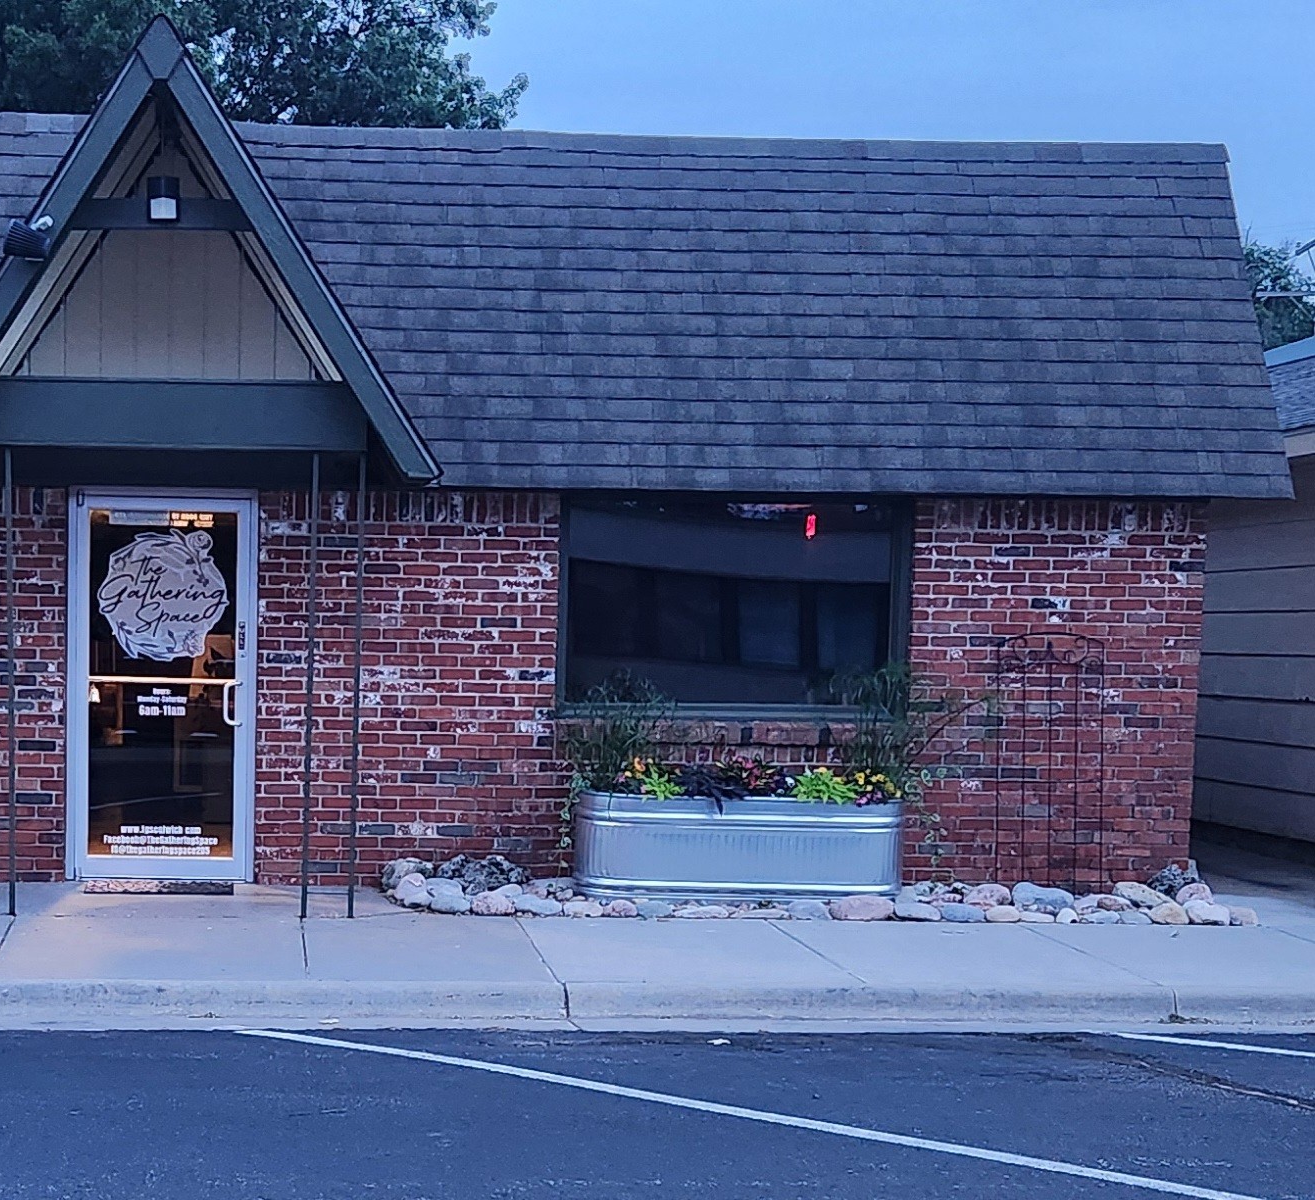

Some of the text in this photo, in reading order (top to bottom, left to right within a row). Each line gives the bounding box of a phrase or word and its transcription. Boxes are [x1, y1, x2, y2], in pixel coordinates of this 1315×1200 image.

[131, 555, 168, 586] The
[98, 574, 228, 620] Gathering
[134, 601, 205, 638] Space
[138, 704, 186, 716] 6am-11am
